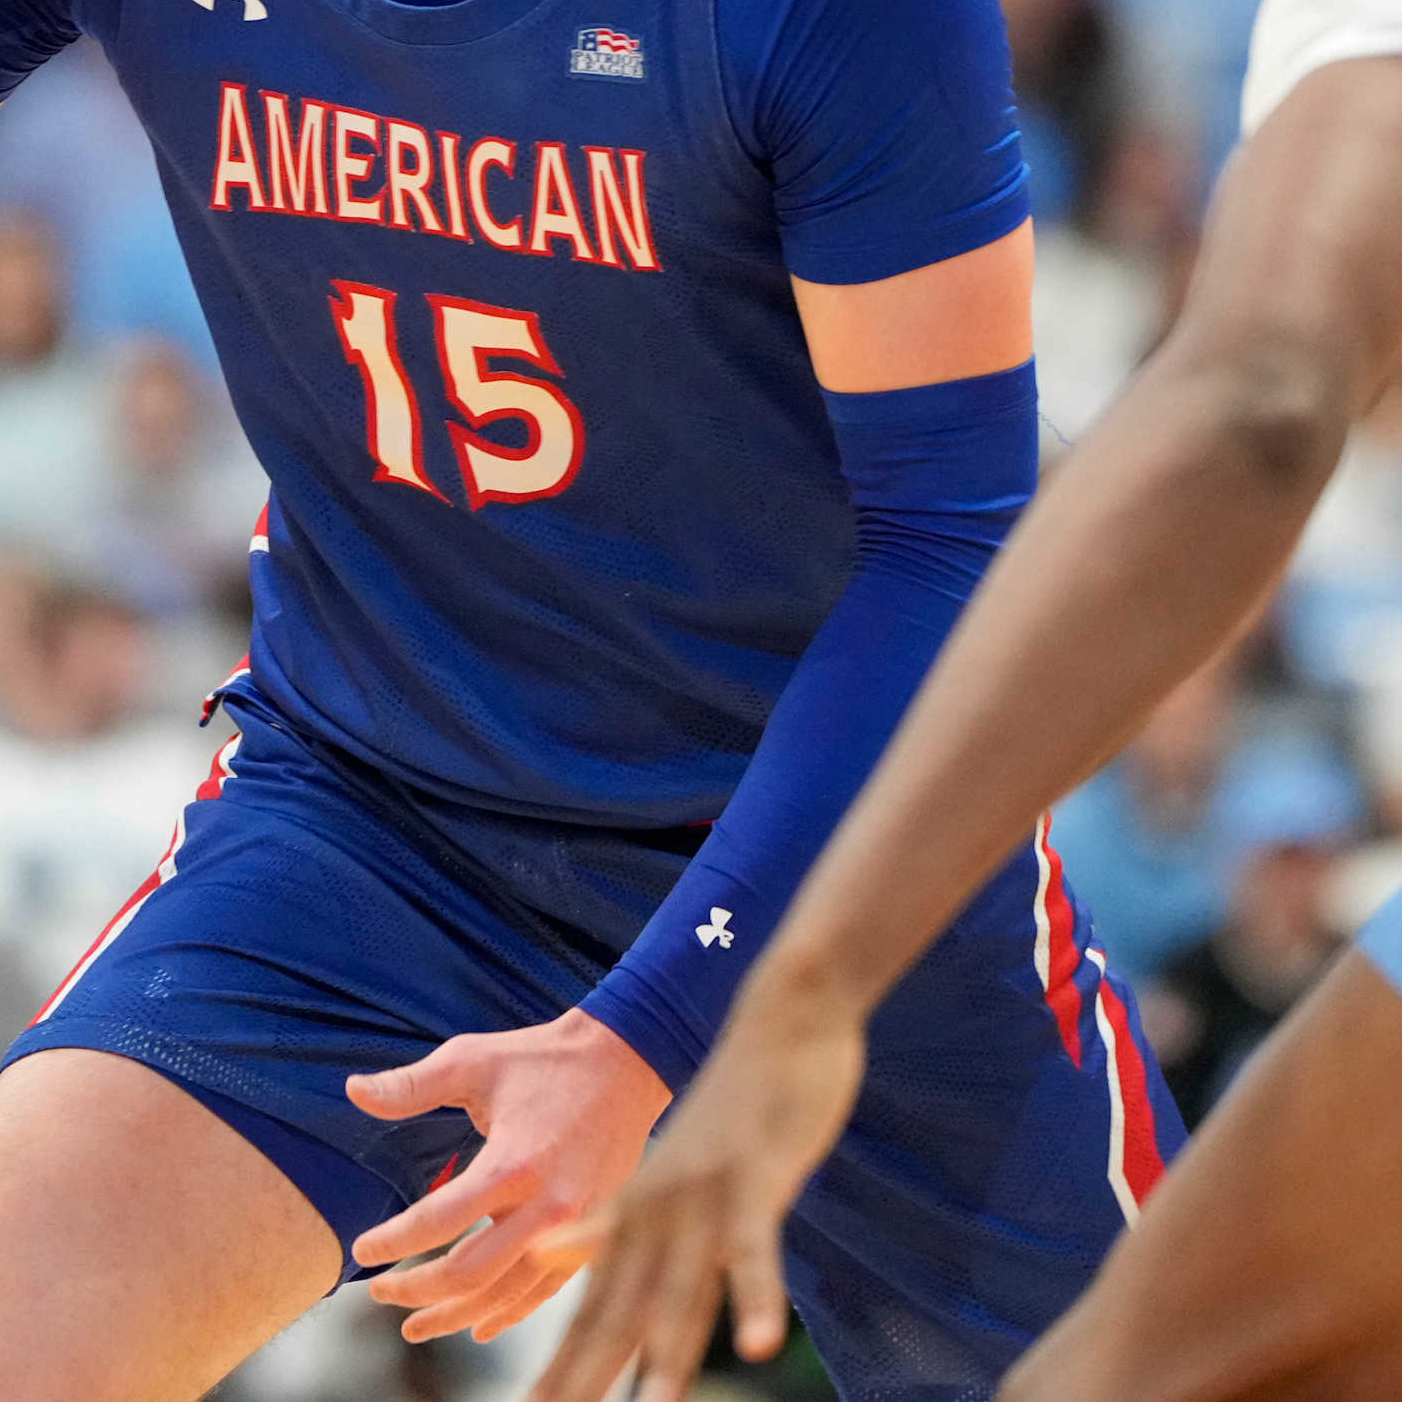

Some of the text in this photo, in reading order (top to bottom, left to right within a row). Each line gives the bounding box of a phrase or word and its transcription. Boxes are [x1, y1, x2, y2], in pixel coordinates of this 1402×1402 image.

[572, 51, 643, 65] PATRIOT
[212, 82, 662, 271] AMERICAN
[329, 280, 584, 510] 15
